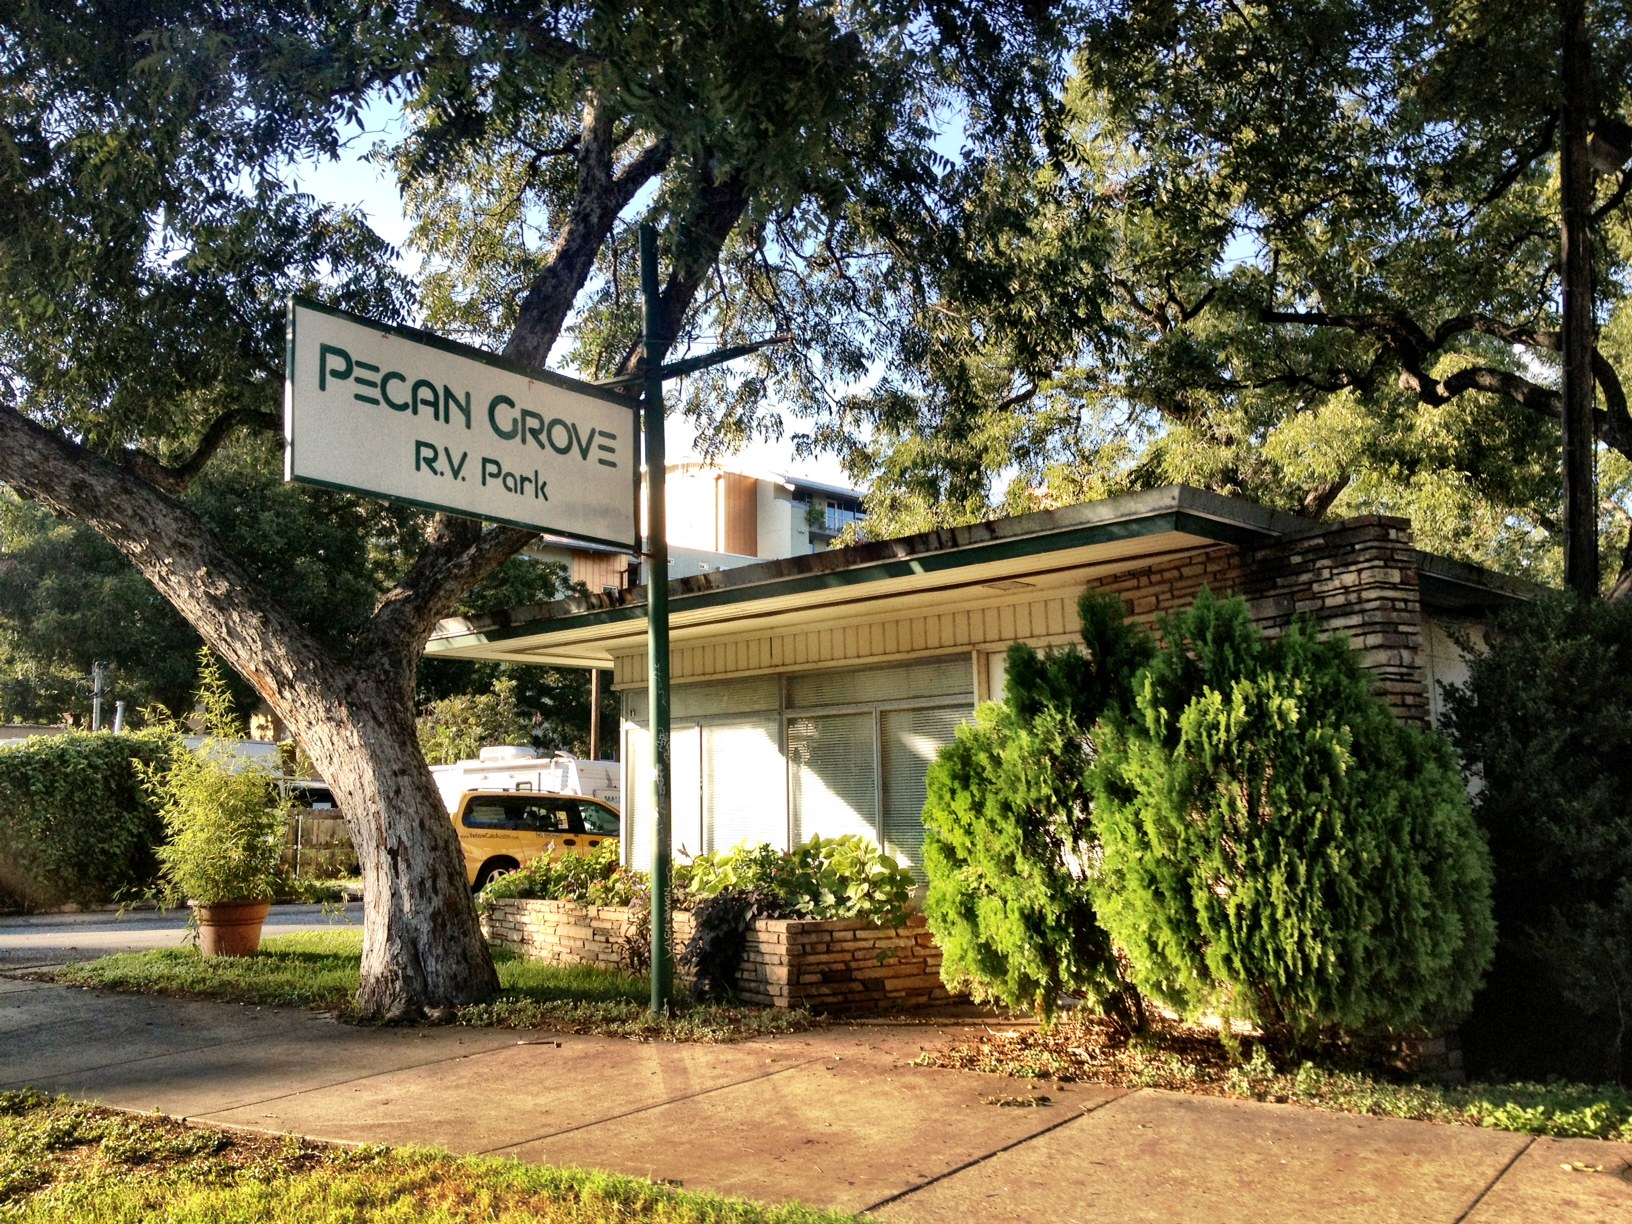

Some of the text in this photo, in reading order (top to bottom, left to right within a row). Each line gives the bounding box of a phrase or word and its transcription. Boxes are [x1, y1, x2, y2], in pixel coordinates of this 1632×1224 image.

[319, 342, 617, 468] PECAN GROVE
[415, 439, 549, 502] R.V. Park
